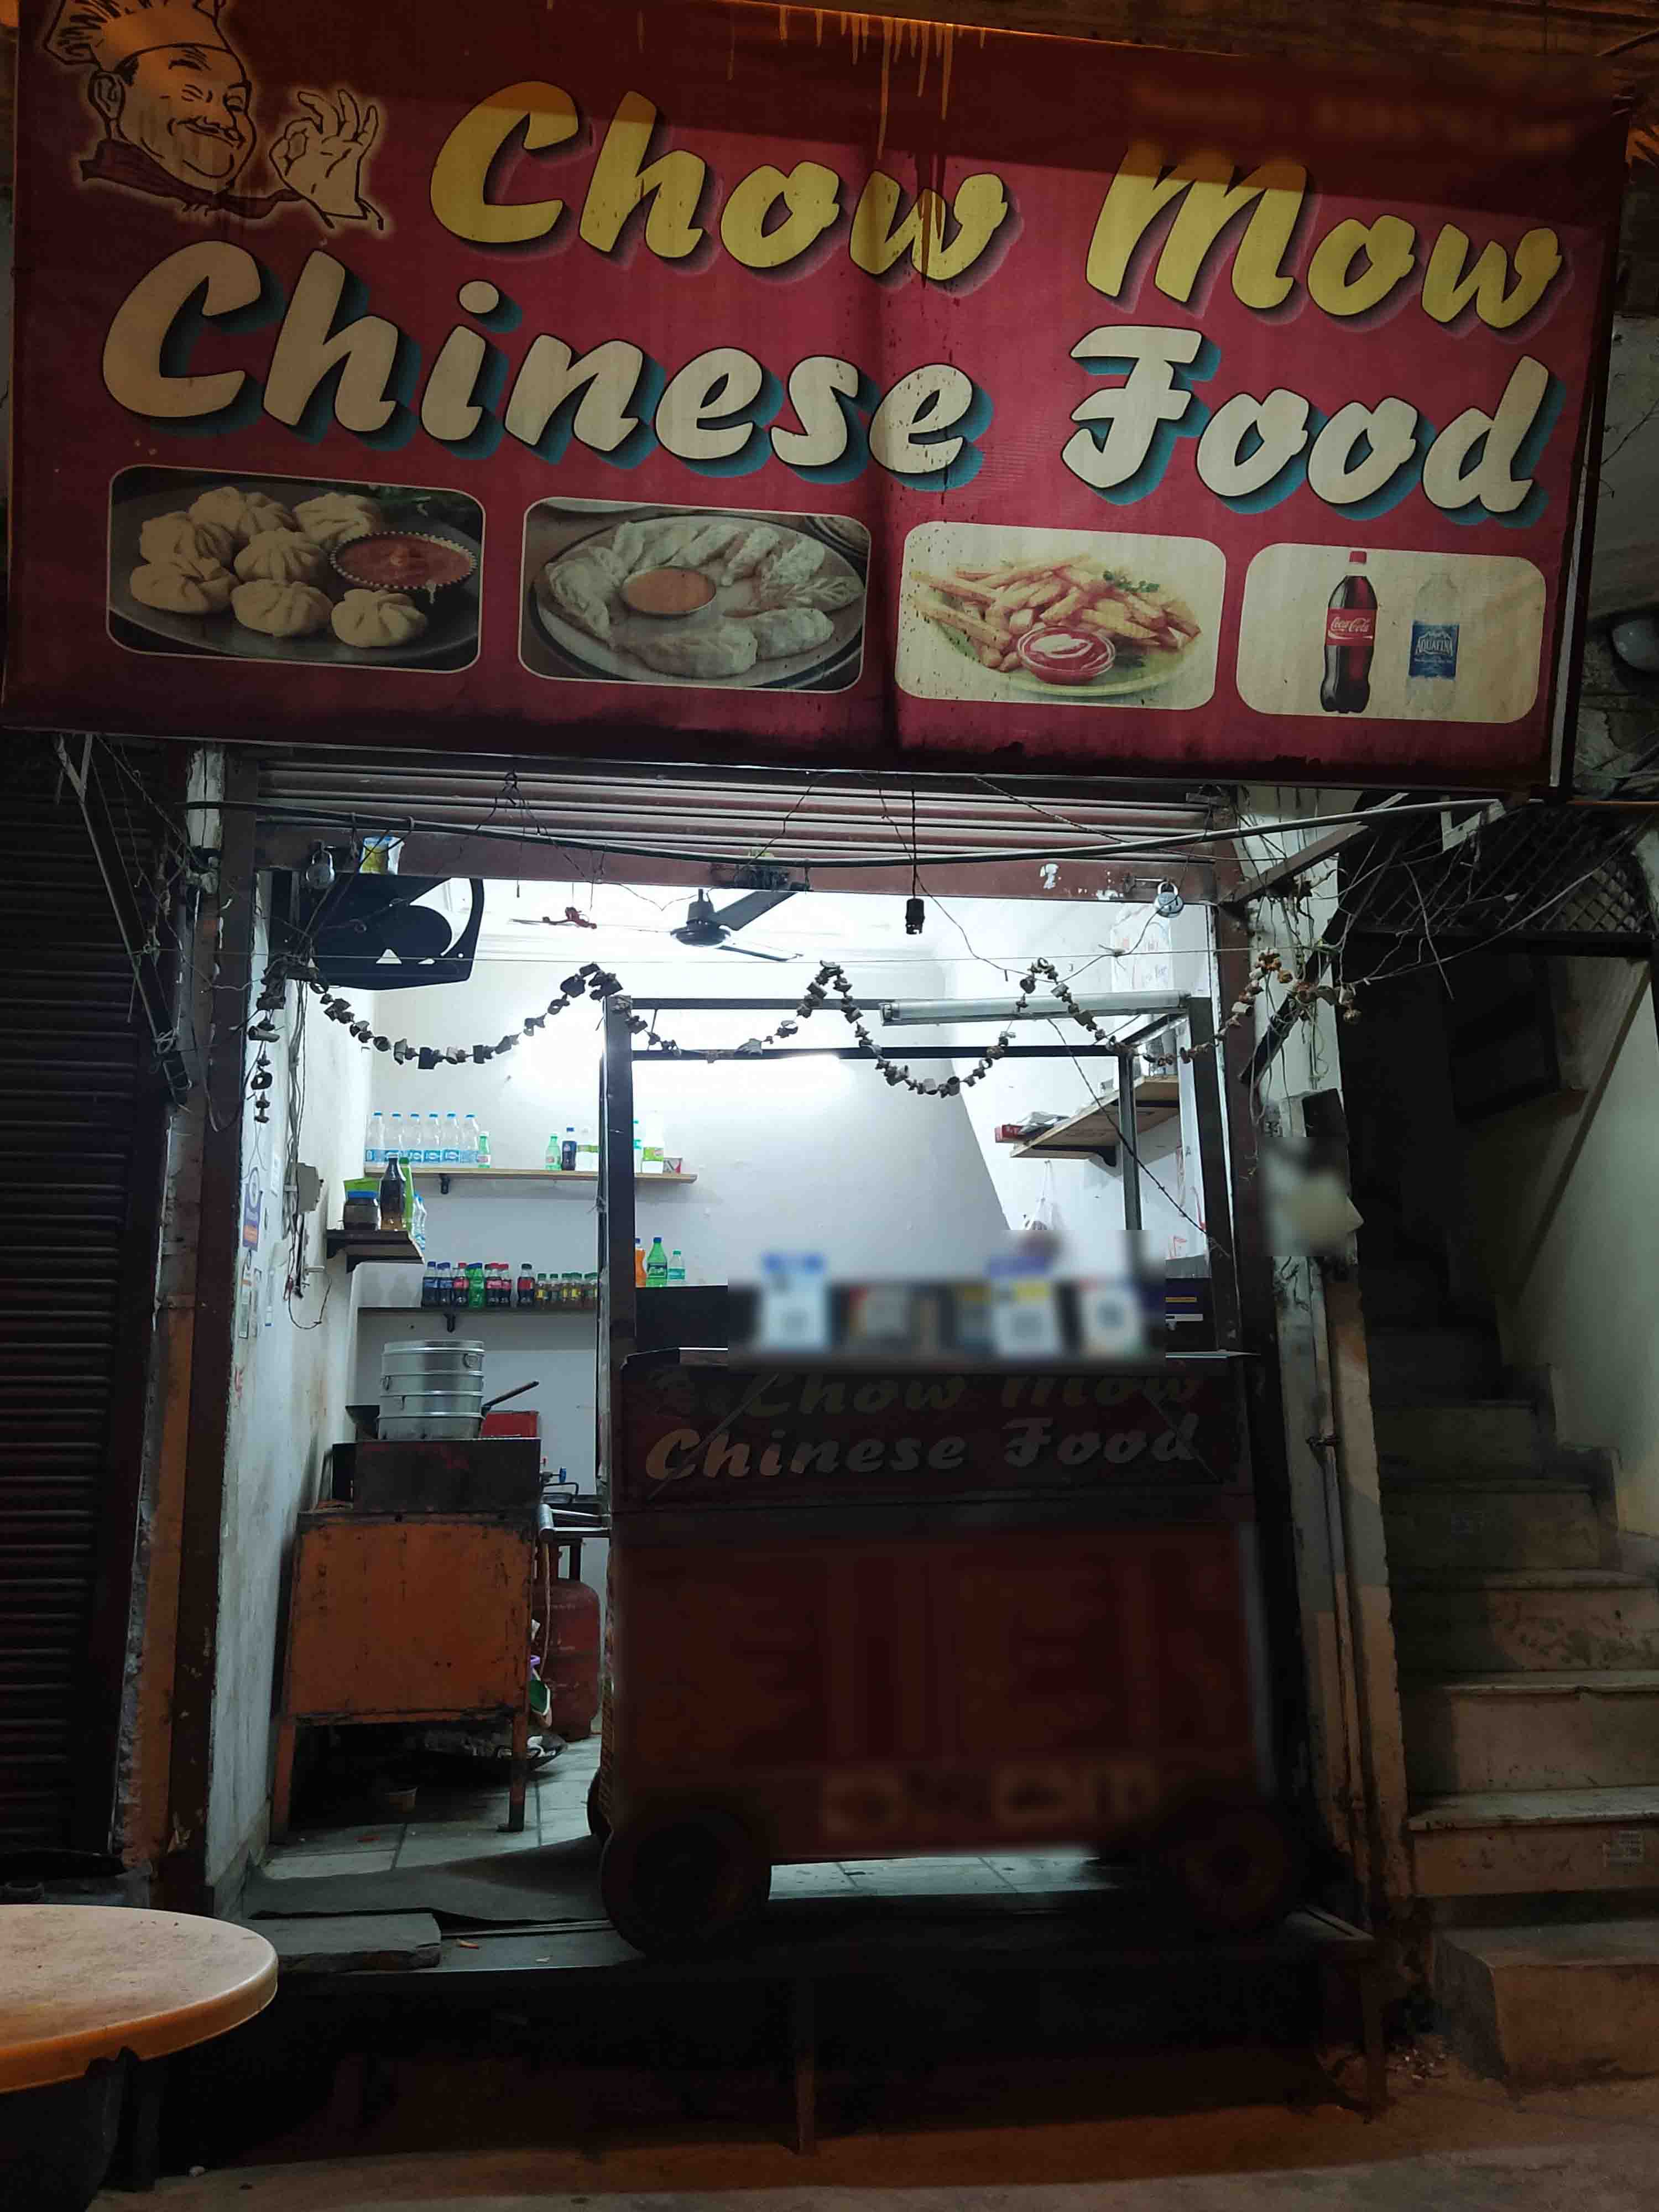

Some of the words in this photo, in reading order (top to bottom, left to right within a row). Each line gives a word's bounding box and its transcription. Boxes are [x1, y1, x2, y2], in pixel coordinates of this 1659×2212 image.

[430, 81, 1009, 280] Chow
[1086, 144, 1562, 328] Mow
[103, 241, 975, 473] Chinese
[1062, 325, 1550, 513] Food
[646, 1428, 966, 1480] Chinese
[1001, 1413, 1200, 1468] Food
